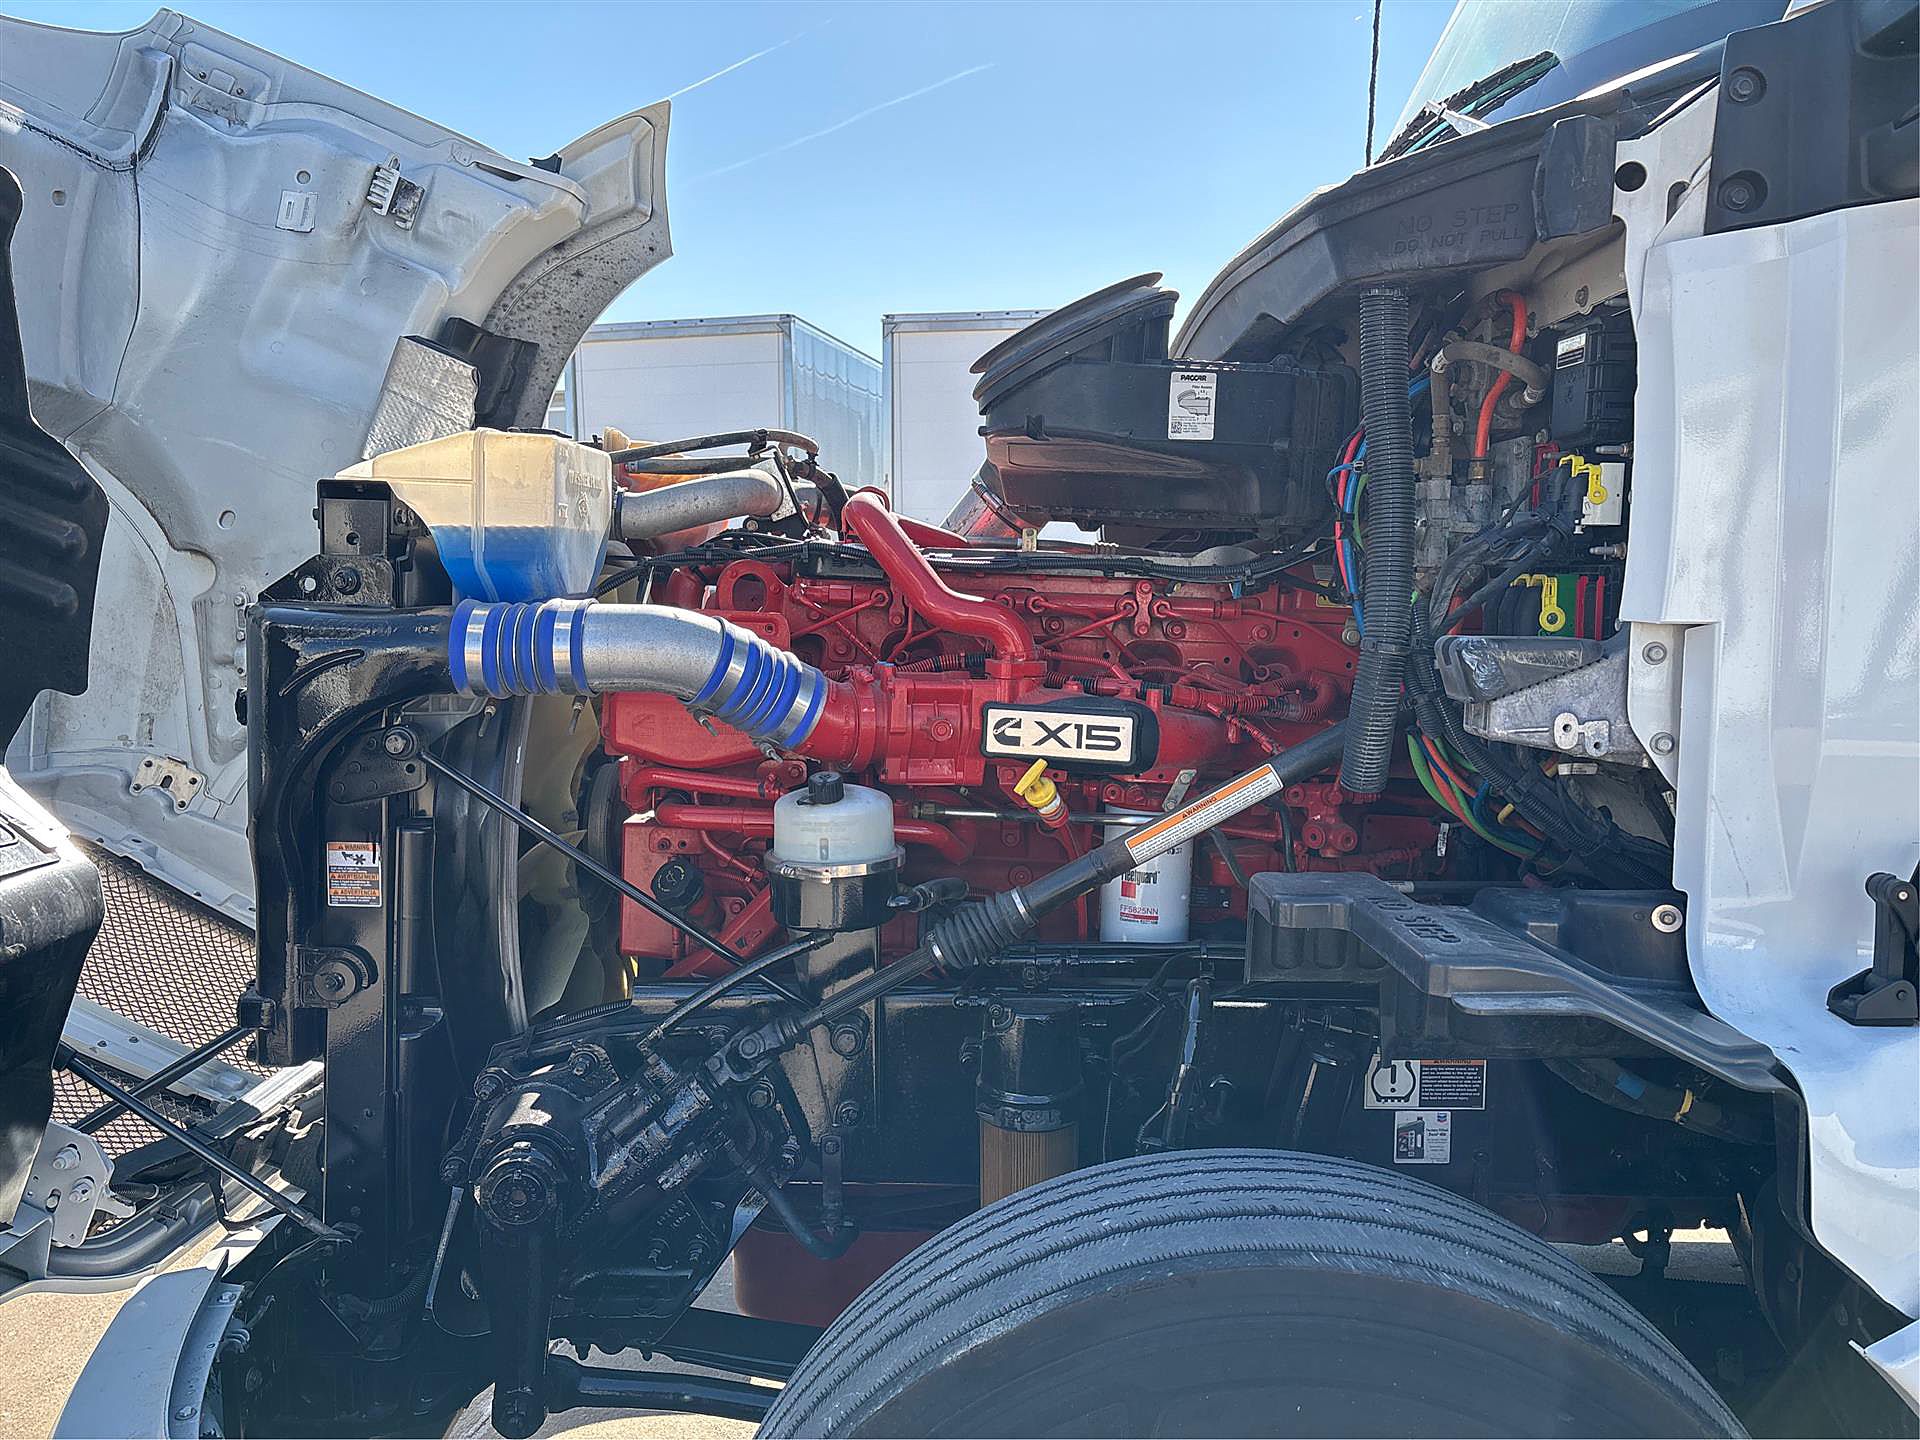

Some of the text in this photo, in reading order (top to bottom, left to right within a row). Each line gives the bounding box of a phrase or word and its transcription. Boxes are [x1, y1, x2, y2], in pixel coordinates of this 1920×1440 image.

[1401, 203, 1520, 234] NO STEP
[1394, 227, 1524, 254] DO NOT PULL
[1180, 374, 1207, 382] PACCAR
[1031, 720, 1122, 752] X15
[1186, 795, 1218, 818] WARNING
[344, 843, 370, 851] WARNING
[1120, 903, 1159, 914] FF5825NN
